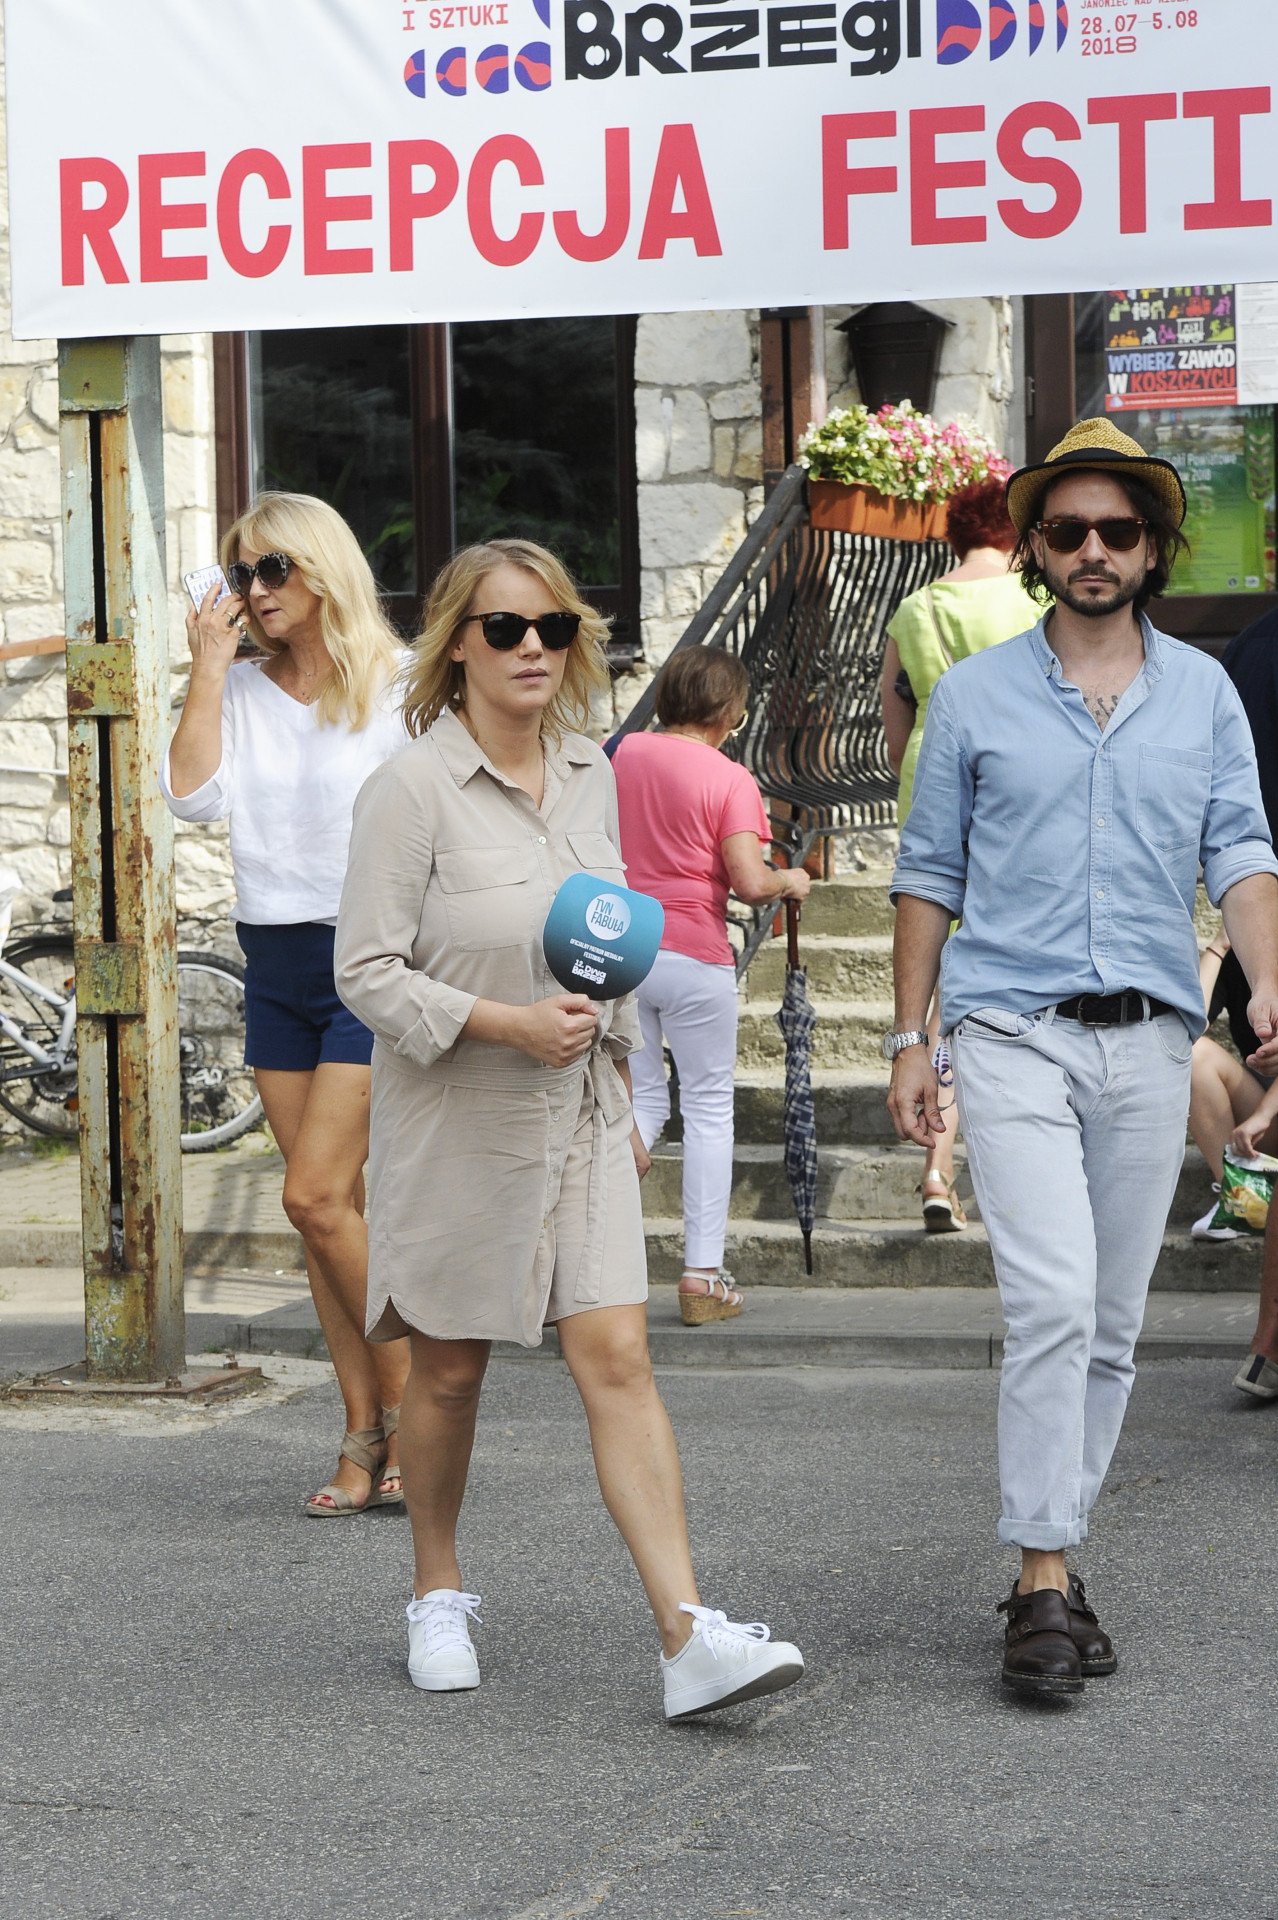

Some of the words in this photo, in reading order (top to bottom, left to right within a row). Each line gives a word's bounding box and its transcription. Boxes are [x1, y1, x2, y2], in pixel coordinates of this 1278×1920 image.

[402, 10, 416, 31] I
[429, 3, 509, 30] SZTUKI
[1081, 35, 1137, 57] 2018
[60, 123, 723, 287] RECEPCJA
[821, 86, 1273, 251] FESTI
[1108, 351, 1176, 373] WYBIERZ
[1178, 344, 1235, 369] ZAWÓD
[1108, 373, 1128, 394] W
[1130, 367, 1235, 393] KOSZCZYCU
[594, 898, 614, 916] TVN
[590, 911, 624, 934] FABUŁA
